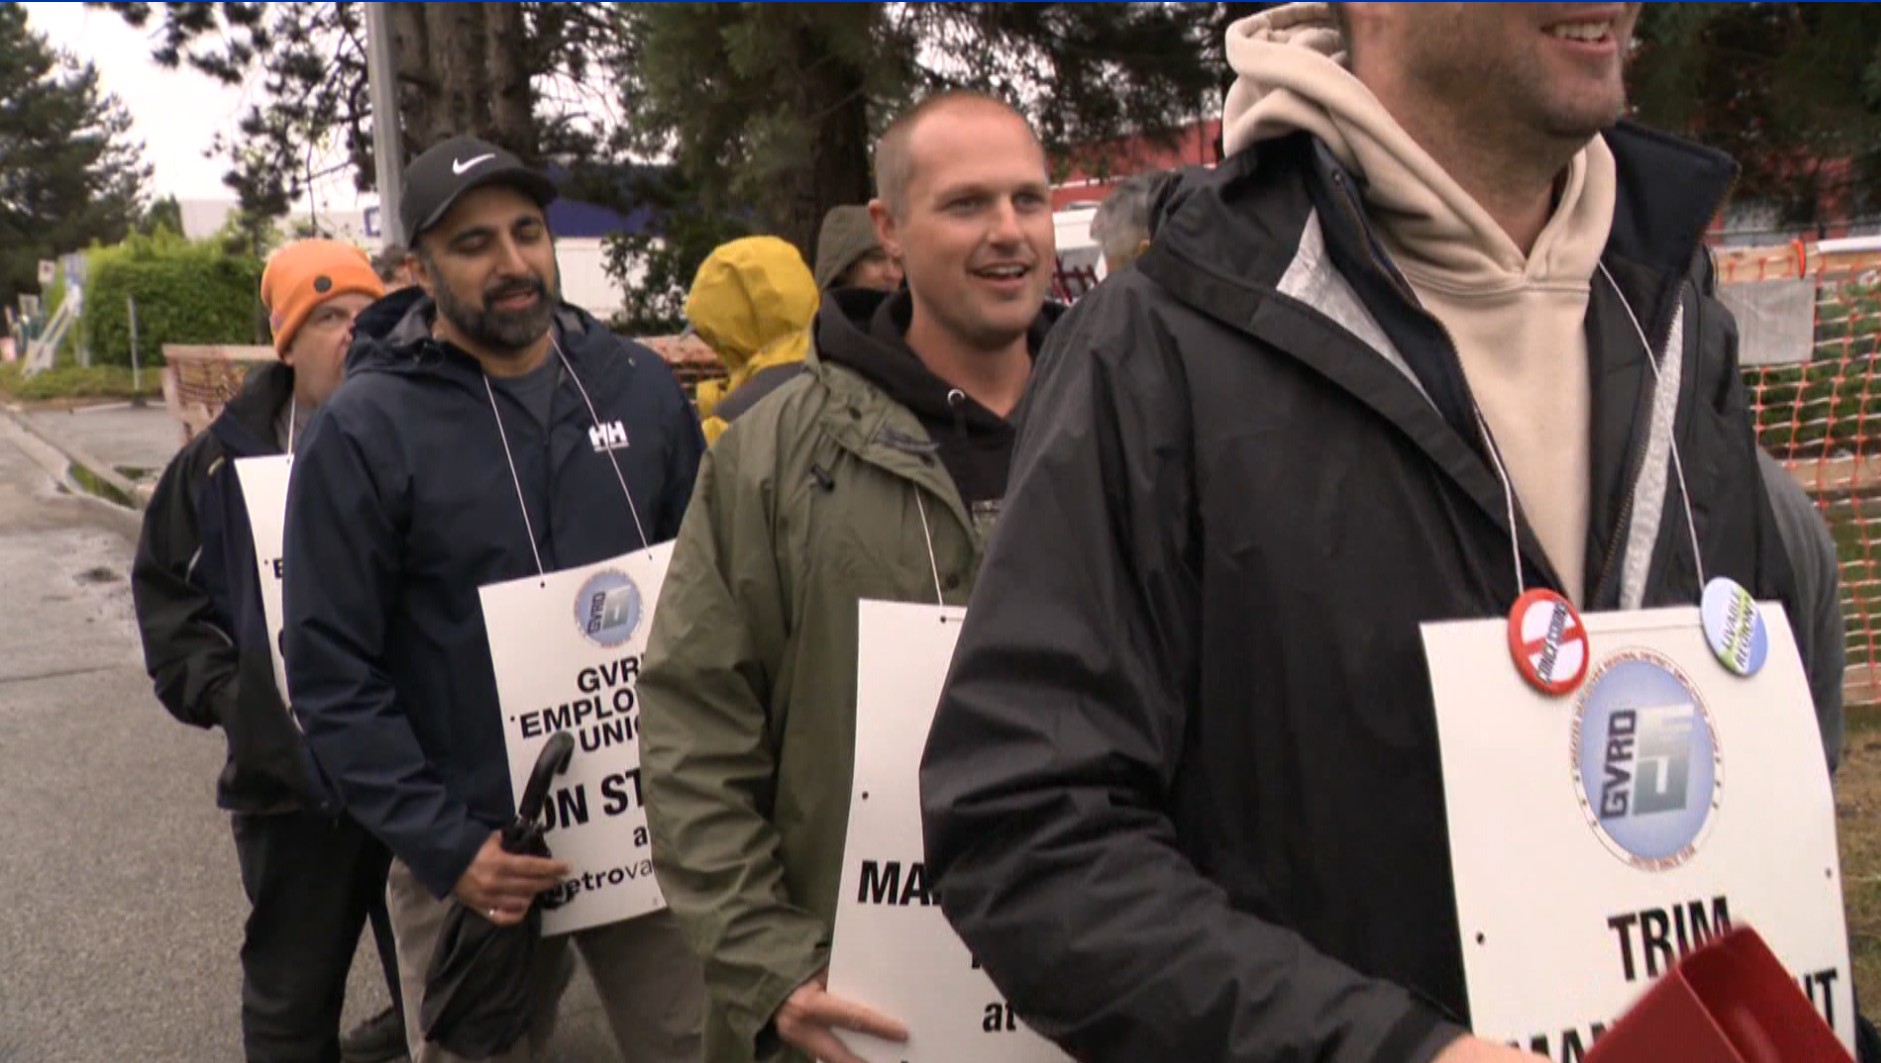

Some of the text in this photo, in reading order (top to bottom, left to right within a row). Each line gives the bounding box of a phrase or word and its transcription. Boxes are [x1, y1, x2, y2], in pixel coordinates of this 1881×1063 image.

[588, 420, 629, 450] HH
[577, 653, 645, 693] GVR
[520, 687, 634, 739] EMPLO
[557, 858, 654, 893] etrova
[857, 860, 942, 906] MA
[1607, 896, 1732, 982] TRIM
